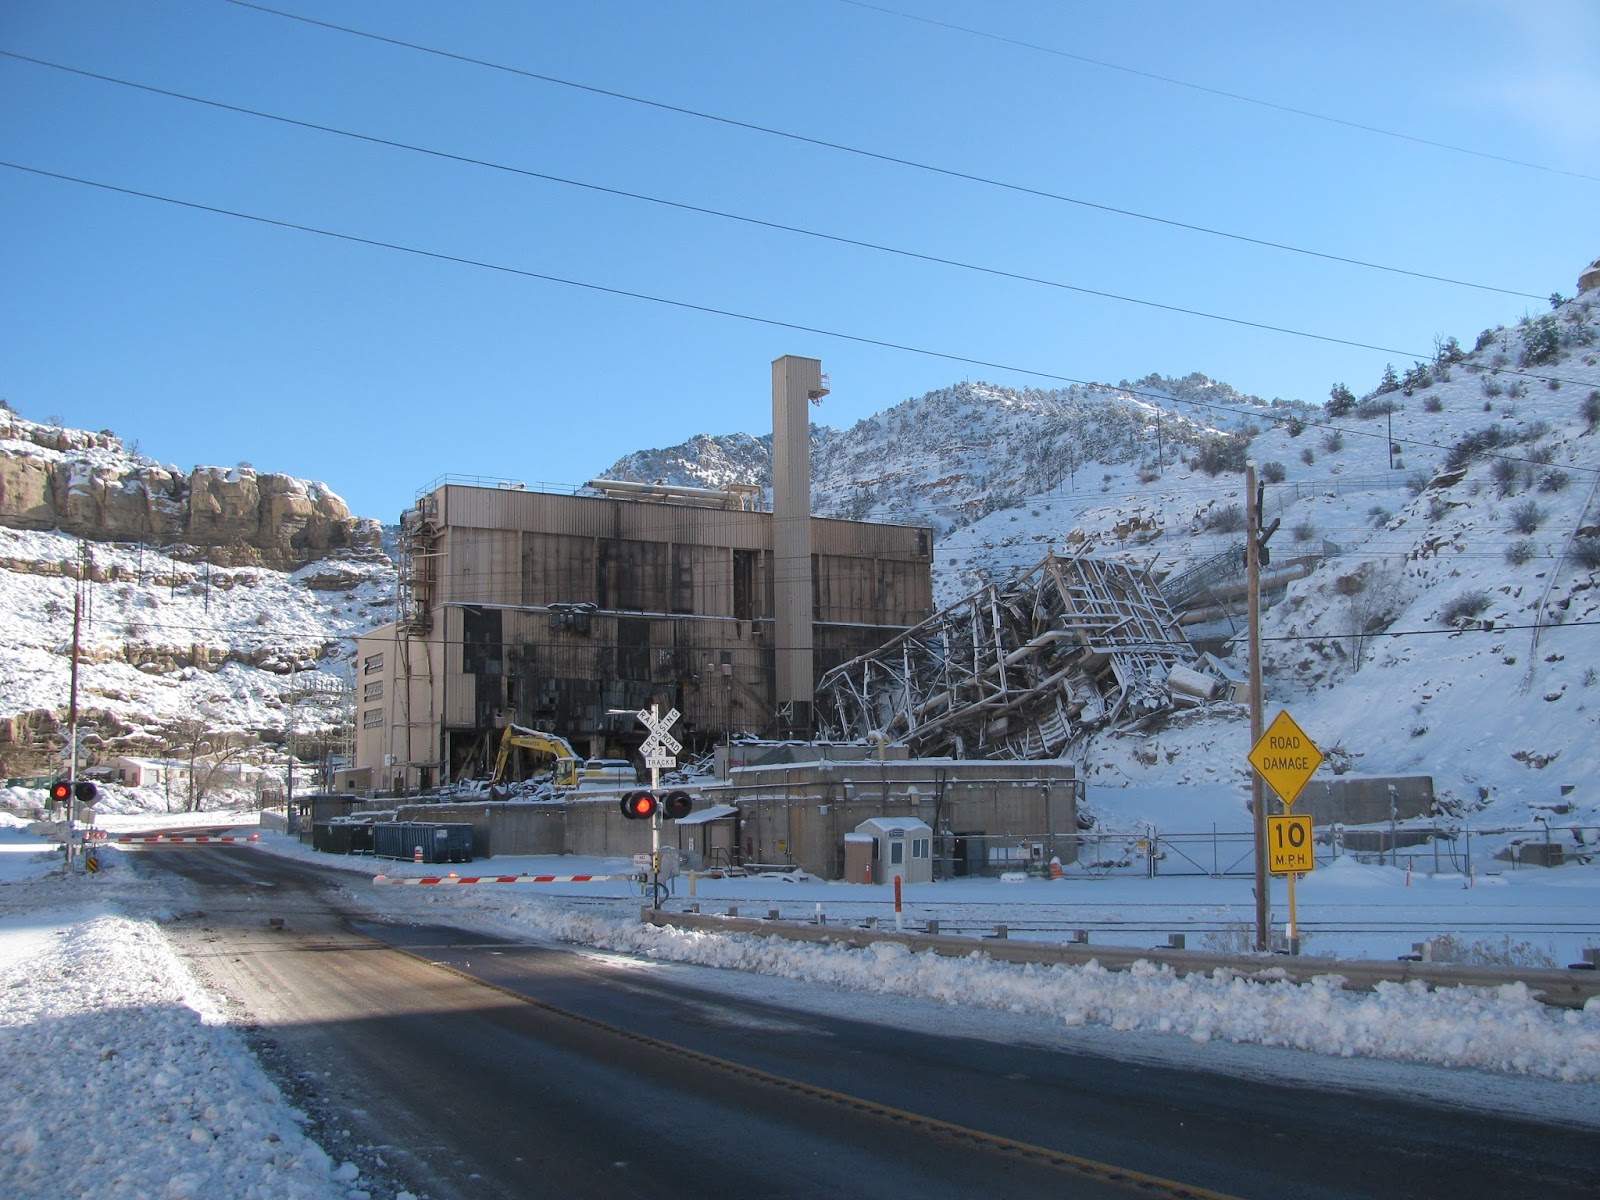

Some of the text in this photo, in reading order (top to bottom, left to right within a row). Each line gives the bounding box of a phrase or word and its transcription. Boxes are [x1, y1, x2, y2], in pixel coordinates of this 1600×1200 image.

[641, 710, 679, 754] CROSSING
[61, 728, 90, 757] CROSING
[1270, 737, 1300, 749] ROAD
[658, 748, 664, 756] 2
[1263, 757, 1309, 770] DAMAGE
[1275, 822, 1305, 848] 10
[1275, 854, 1308, 865] M.P.H.
